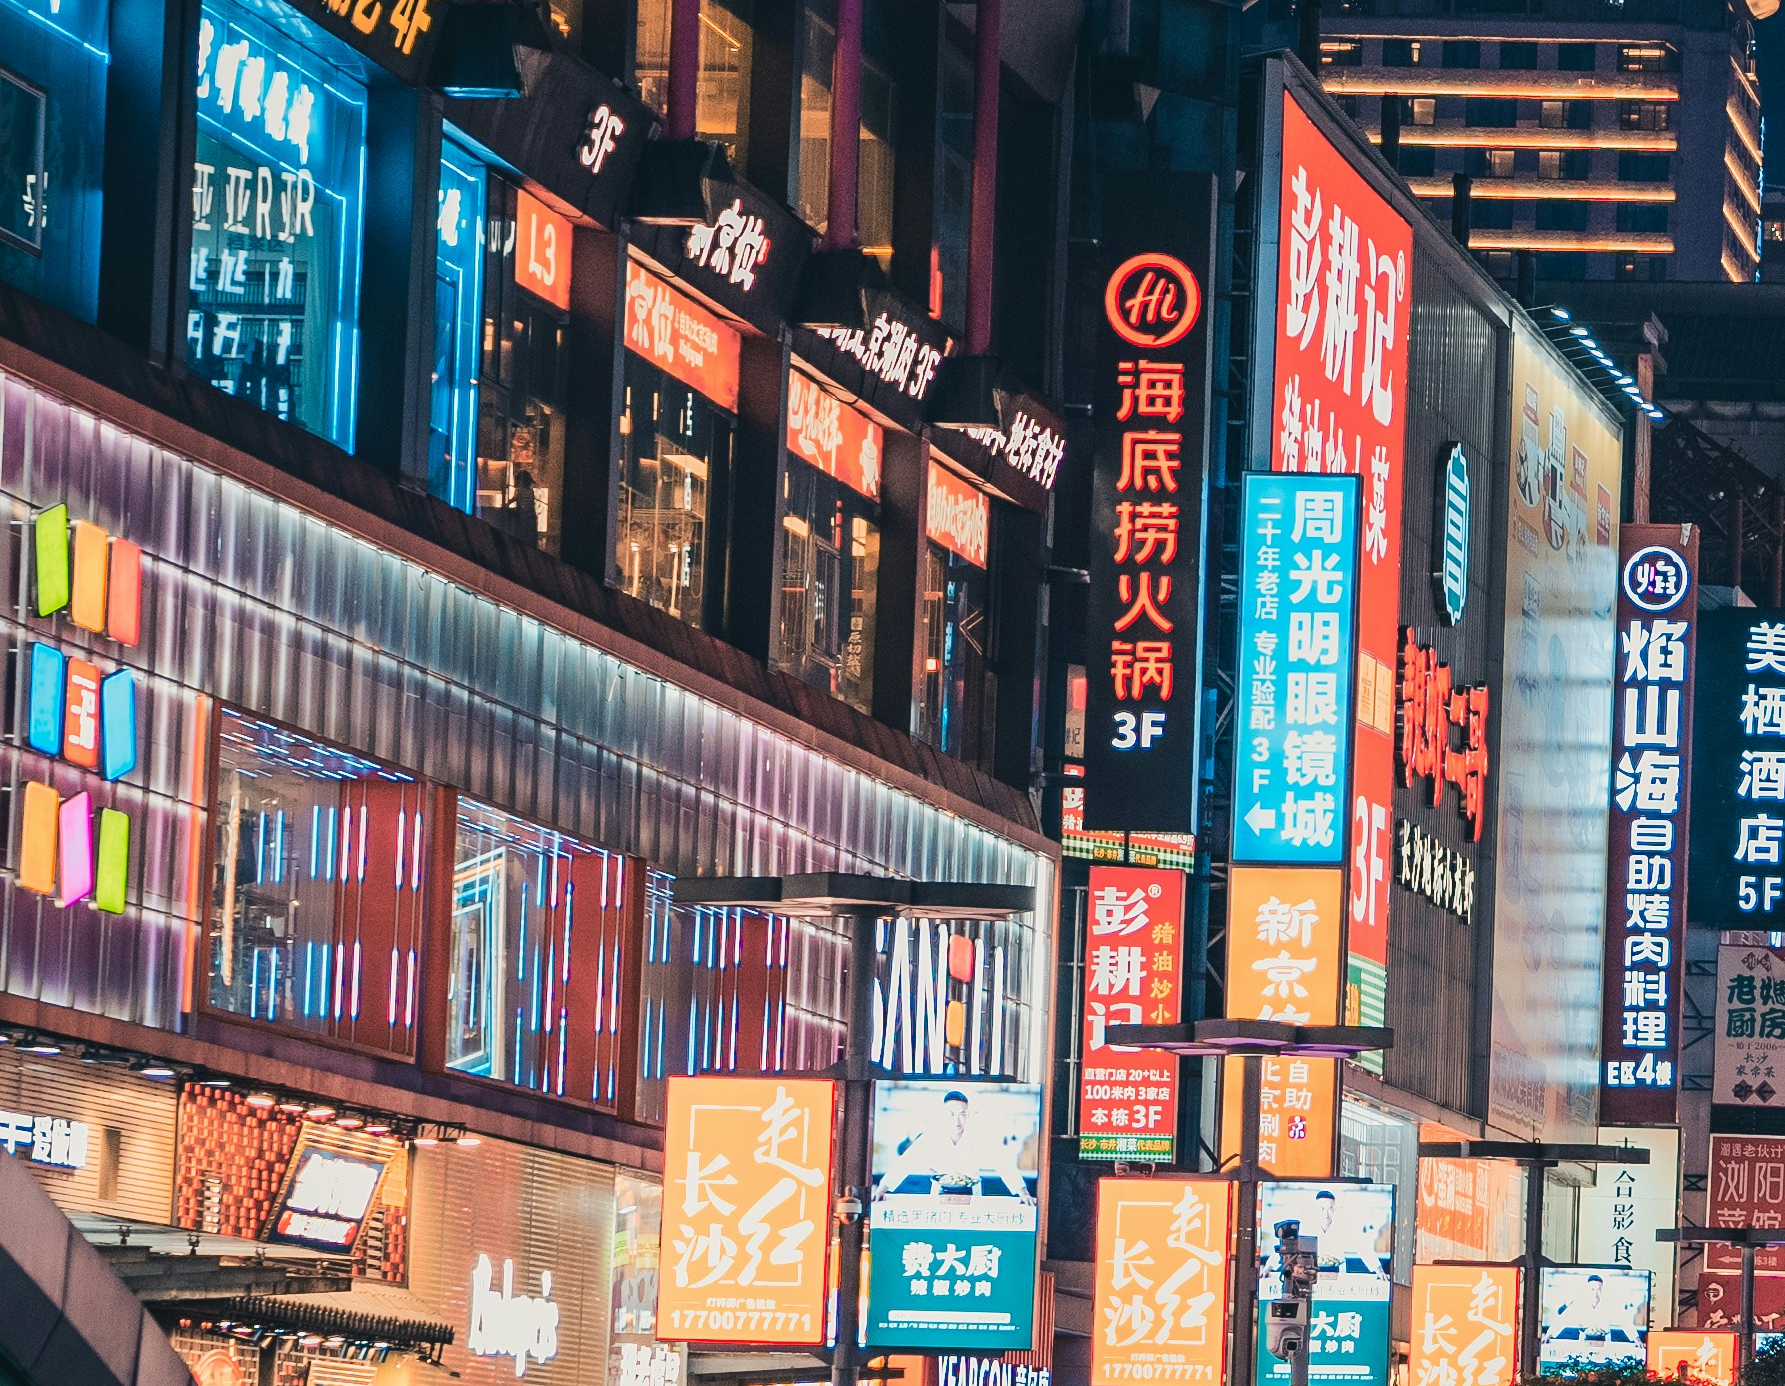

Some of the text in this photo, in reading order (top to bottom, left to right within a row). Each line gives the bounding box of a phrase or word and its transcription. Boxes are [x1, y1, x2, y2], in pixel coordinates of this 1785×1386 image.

[579, 104, 625, 174] 3F
[529, 213, 556, 286] L3
[1286, 165, 1396, 427] 彭耕记
[909, 344, 943, 399] 3F
[1110, 361, 1186, 749] 海底捞火锅 3F
[1249, 497, 1282, 794] 二十年老店 专业验配 3F
[1281, 489, 1343, 848] 周光明眼镜城
[1350, 794, 1386, 926] 3F
[1615, 619, 1688, 1049] 焰山海 自助烤肉料理
[1738, 878, 1783, 913] 5F
[1087, 887, 1150, 1052] 彭耕记
[1150, 922, 1176, 1052] 猪油炒小
[1283, 1060, 1312, 1111] 自助
[1607, 1053, 1673, 1088] E区4楼
[1716, 1159, 1785, 1204] 浏阳
[671, 1152, 738, 1289] 长沙
[902, 1241, 1002, 1278] 费大厨
[910, 1279, 992, 1297] 辣椒炒肉
[1103, 1238, 1156, 1347] 长沙
[670, 1310, 811, 1332] 17700777771
[1102, 1362, 1213, 1381] 17700777771
